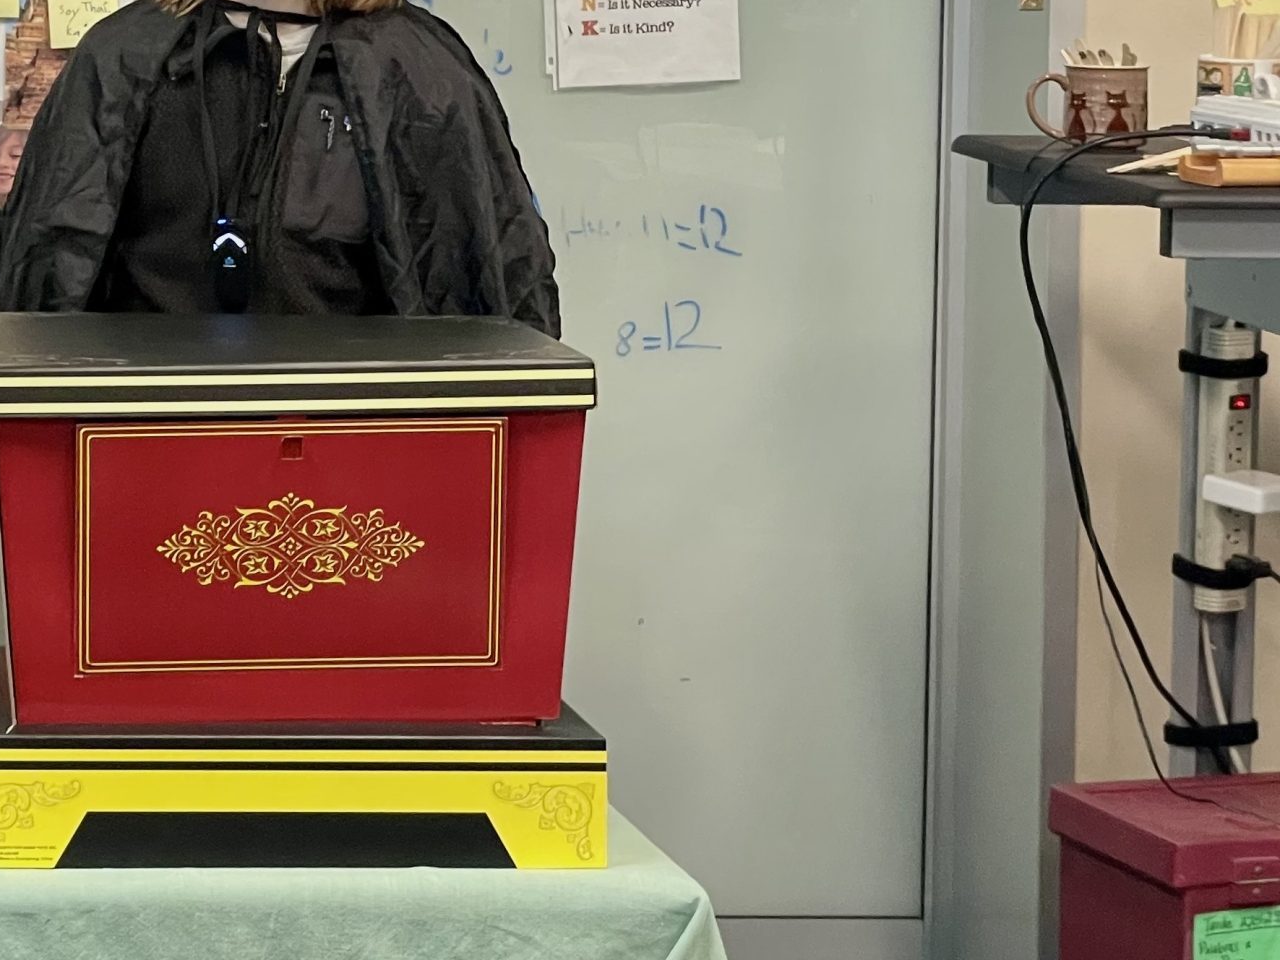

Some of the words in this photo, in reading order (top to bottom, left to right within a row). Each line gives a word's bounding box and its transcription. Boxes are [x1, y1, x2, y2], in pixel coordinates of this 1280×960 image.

[608, 0, 618, 10] Is
[621, 0, 631, 9] it
[609, 23, 620, 35] Is
[623, 22, 633, 33] it
[636, 21, 675, 34] Kind?
